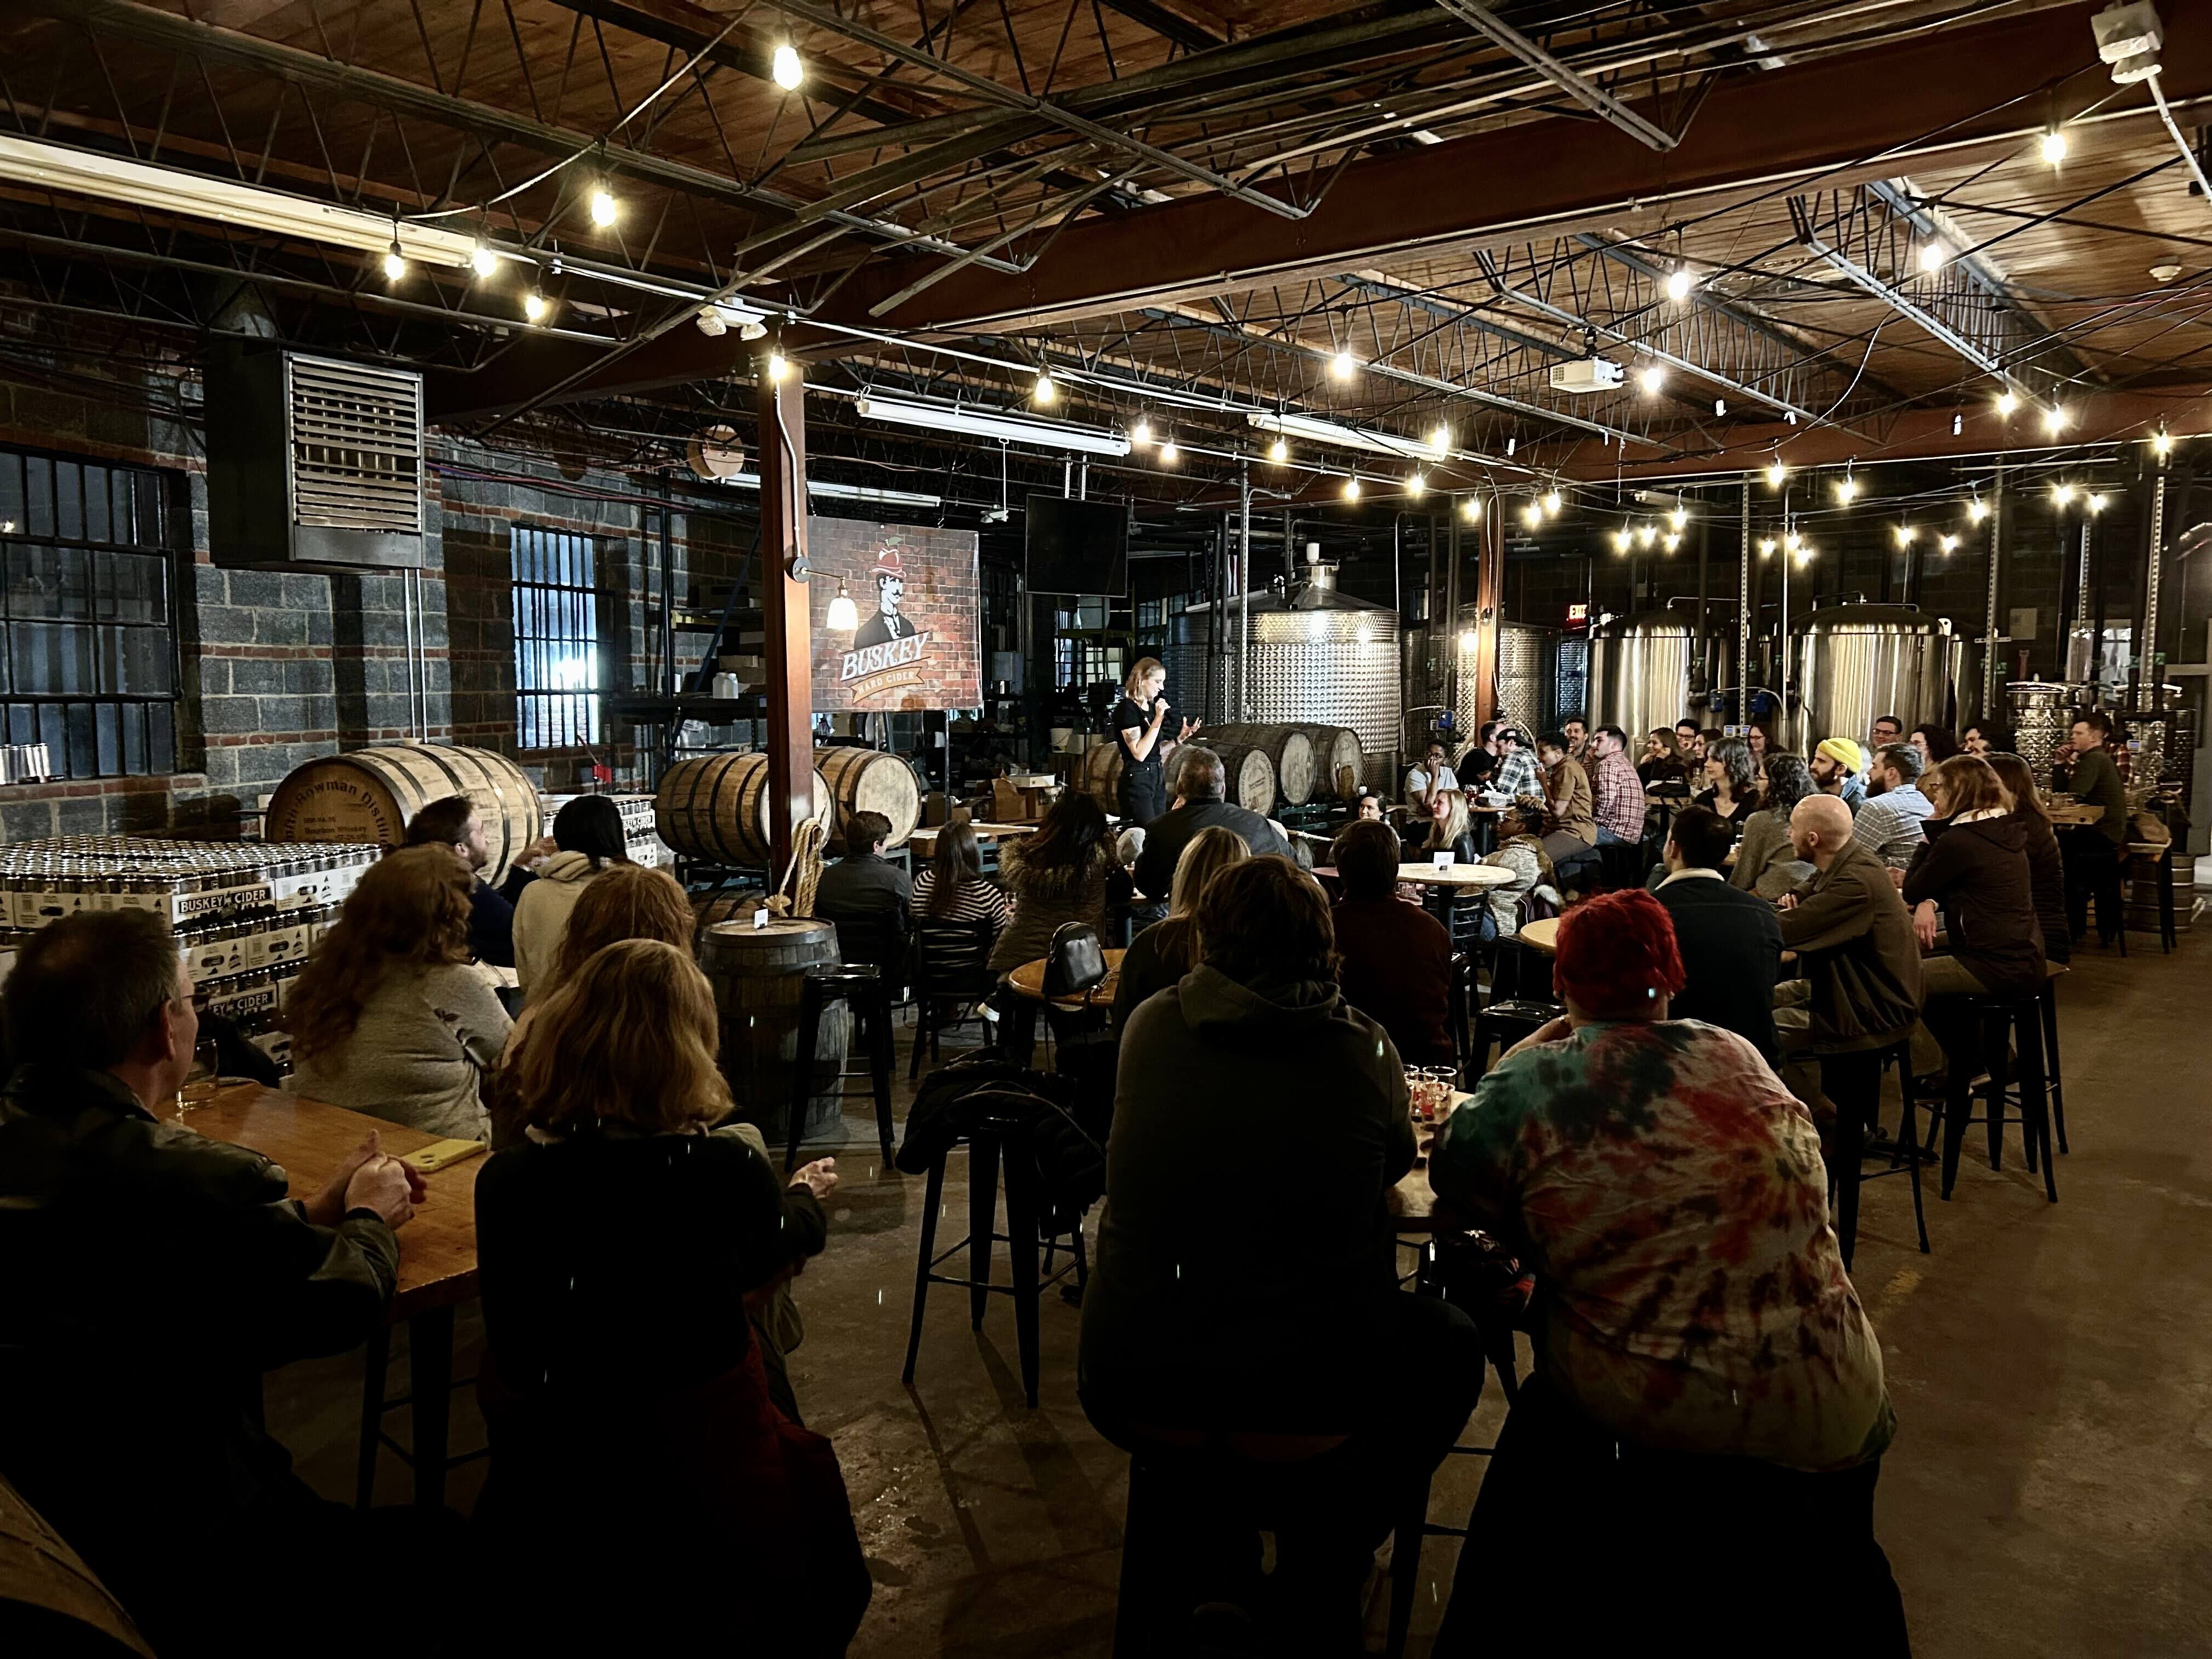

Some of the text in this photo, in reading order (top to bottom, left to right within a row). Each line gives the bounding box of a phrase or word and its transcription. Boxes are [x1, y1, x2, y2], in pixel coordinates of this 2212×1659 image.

[1570, 605, 1587, 619] EXIT
[840, 632, 929, 681] BUSKEY
[859, 672, 915, 694] HARD CIDER
[295, 780, 358, 805] Bowman
[361, 792, 390, 847] Distille
[180, 895, 223, 913] BUSKEY
[234, 889, 266, 904] CIDER
[236, 993, 268, 1009] CIDER
